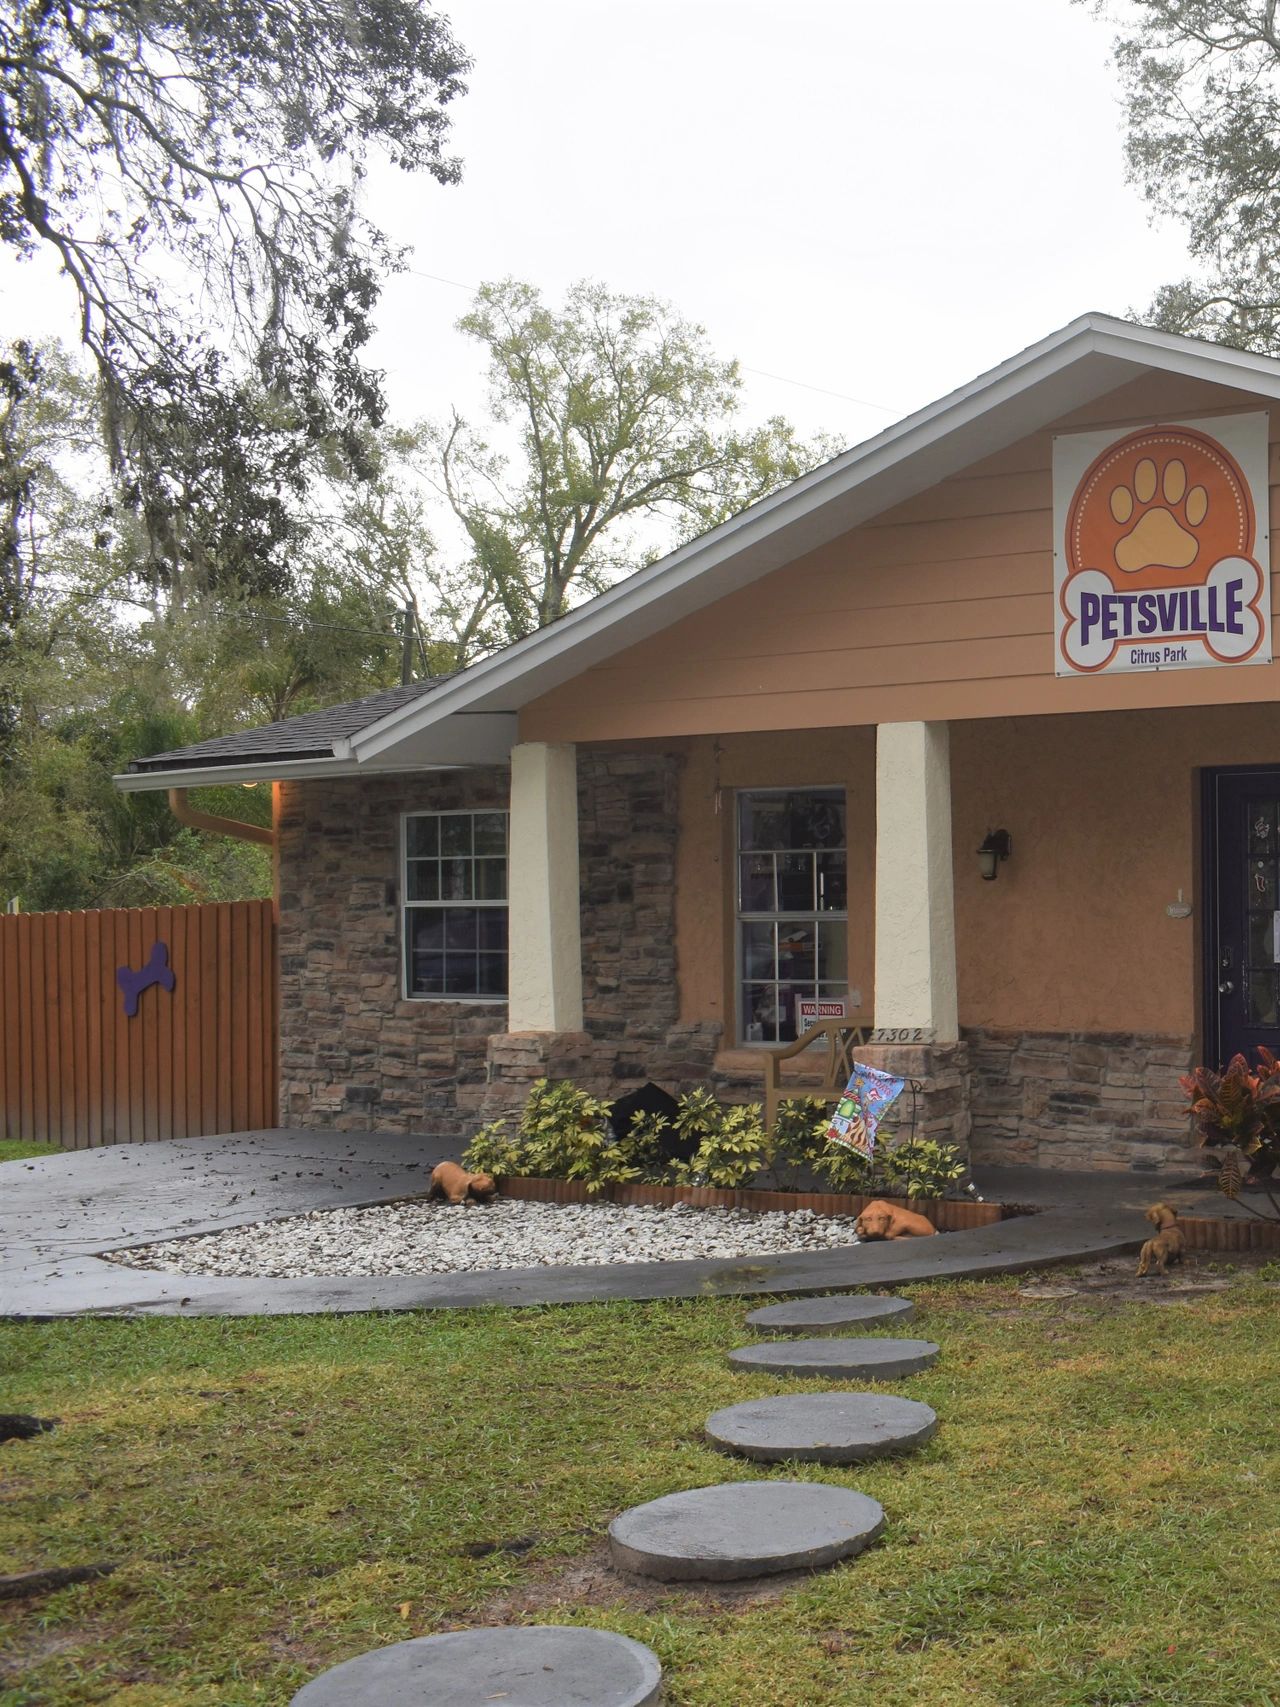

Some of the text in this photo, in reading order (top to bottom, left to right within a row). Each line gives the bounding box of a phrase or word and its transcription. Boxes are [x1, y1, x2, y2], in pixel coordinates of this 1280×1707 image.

[1081, 578, 1243, 646] PETSVILLE
[1130, 646, 1187, 665] Citrus Park
[802, 1004, 842, 1015] WARNING
[877, 1028, 923, 1041] 7302
